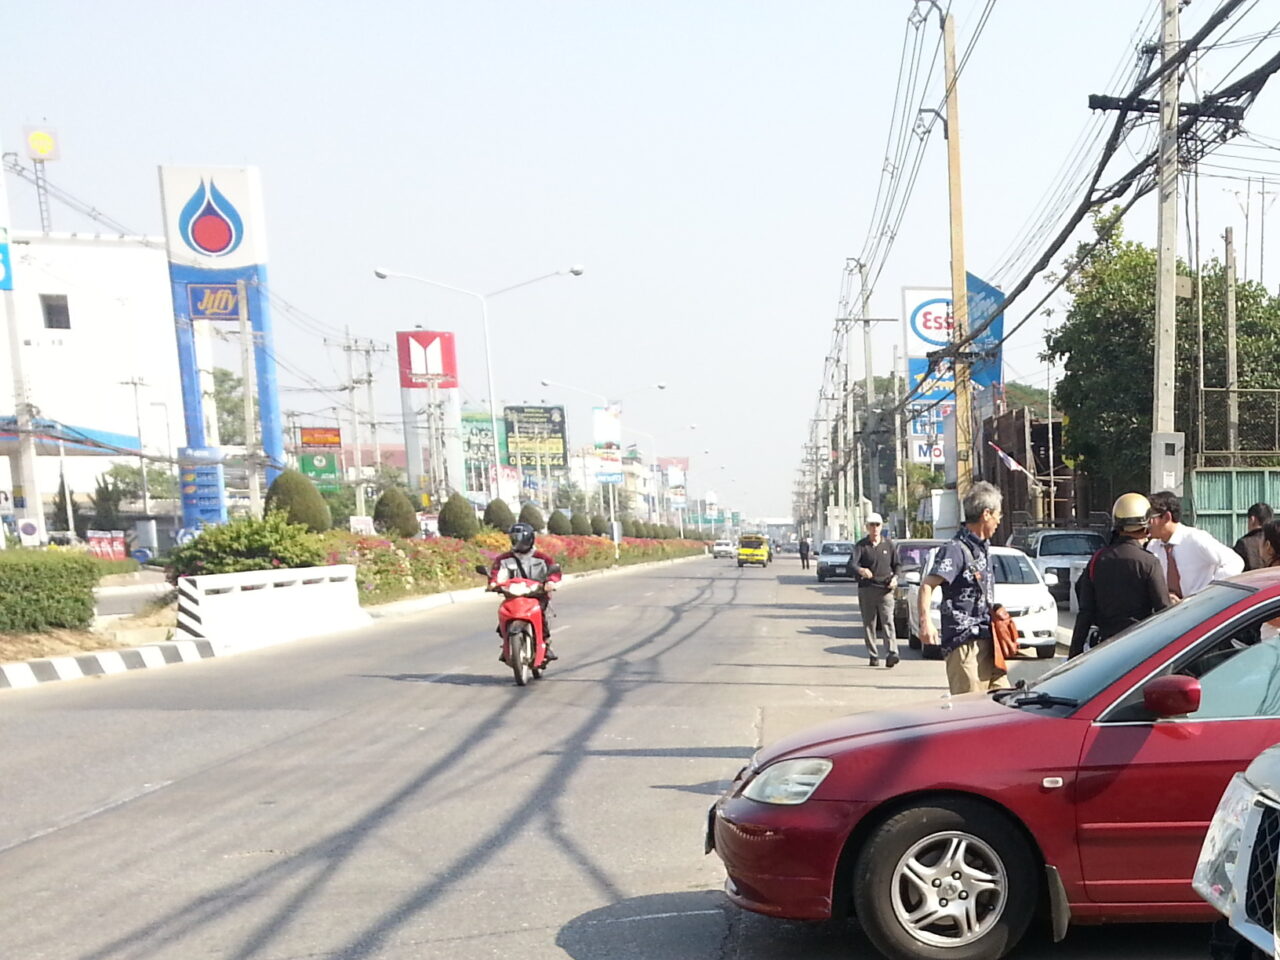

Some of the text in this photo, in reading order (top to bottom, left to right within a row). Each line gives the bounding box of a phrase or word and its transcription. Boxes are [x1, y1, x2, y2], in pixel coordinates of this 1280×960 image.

[197, 289, 238, 314] Jiffy
[922, 311, 954, 330] Ess
[918, 444, 942, 458] Mo
